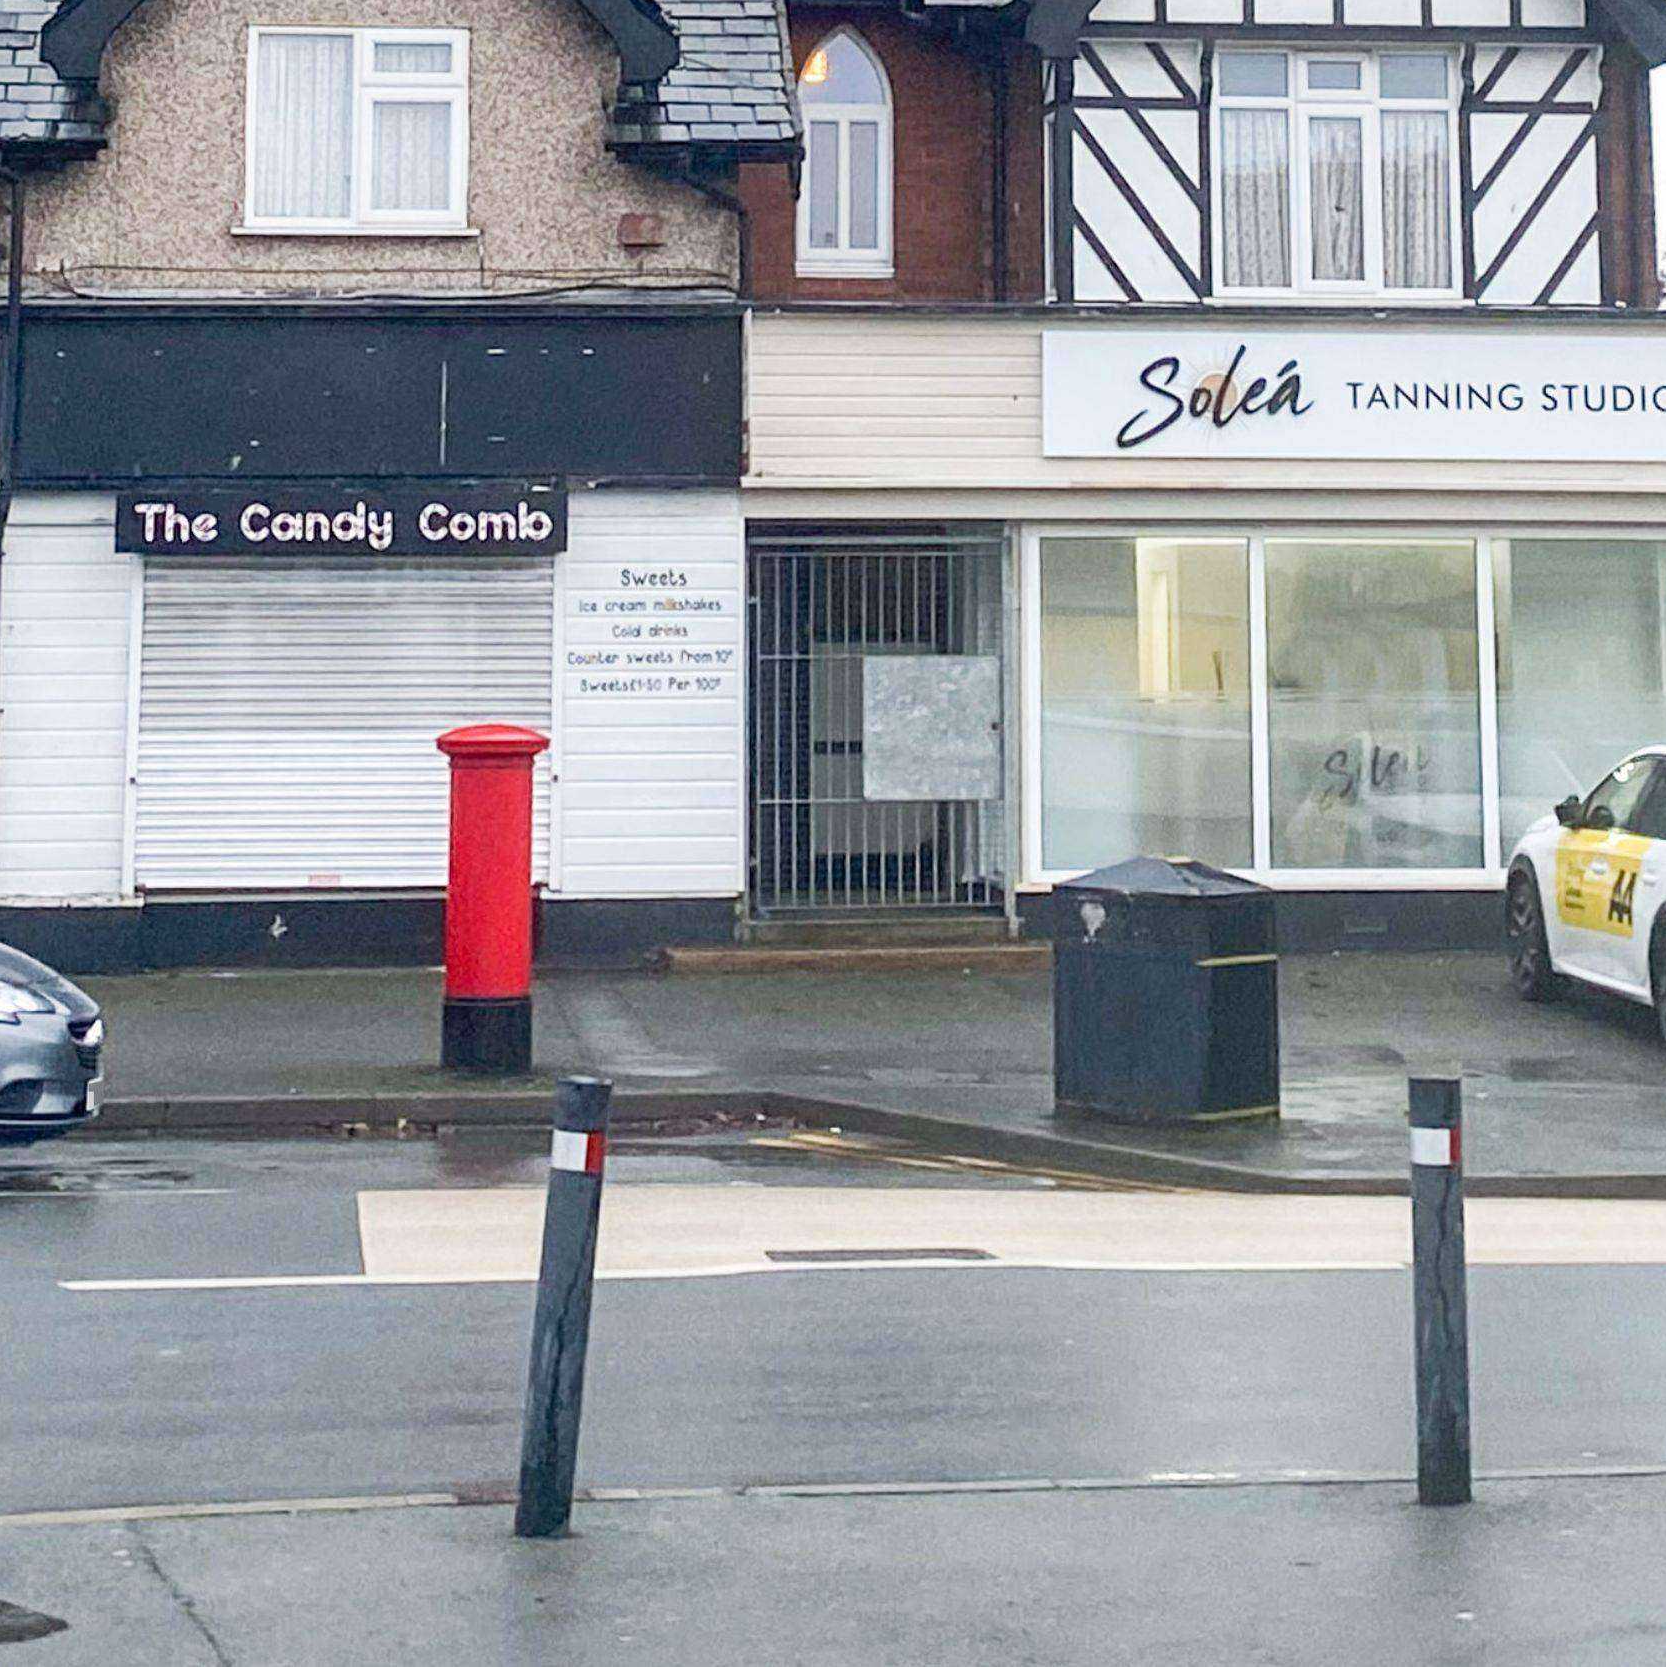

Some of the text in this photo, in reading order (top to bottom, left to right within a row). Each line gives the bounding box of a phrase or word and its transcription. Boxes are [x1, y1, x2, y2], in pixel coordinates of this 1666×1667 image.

[1116, 344, 1314, 449] Soleá
[1346, 381, 1524, 412] TANNING
[133, 500, 554, 551] The Candy Comb
[620, 569, 688, 587] Sweets
[604, 600, 647, 612] cream
[611, 624, 689, 638] Cold drinks
[626, 650, 673, 664] sweets
